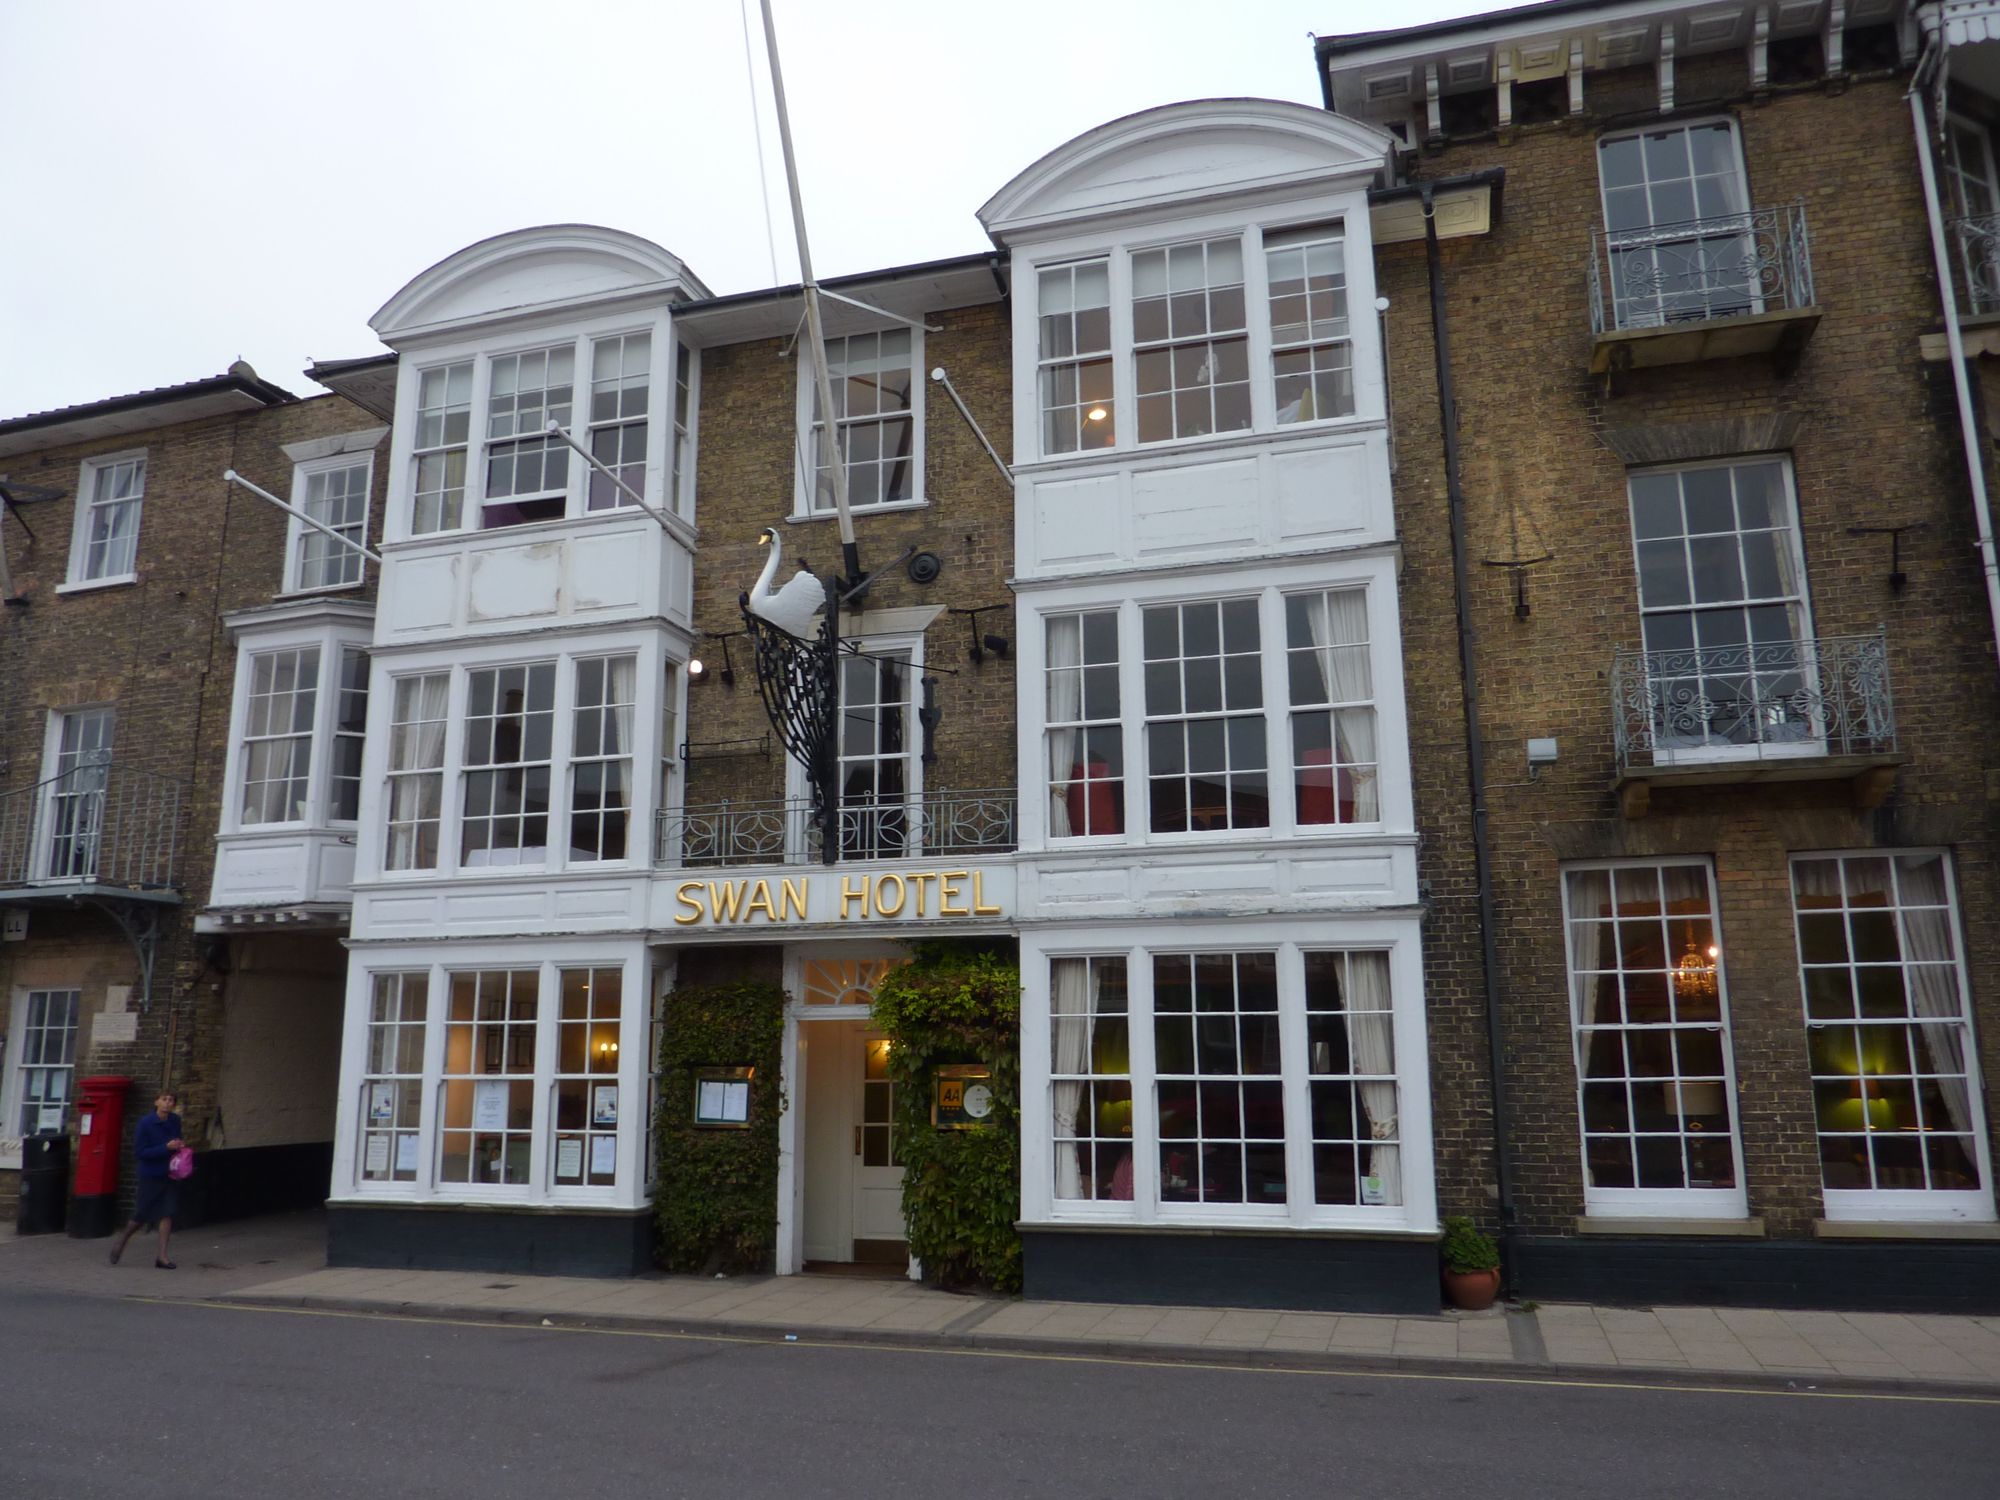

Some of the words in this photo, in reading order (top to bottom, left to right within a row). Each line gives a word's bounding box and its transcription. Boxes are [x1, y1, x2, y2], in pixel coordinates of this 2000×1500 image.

[674, 877, 809, 925] SWAN
[839, 870, 1002, 919] HOTEL
[943, 1087, 960, 1102] AA
